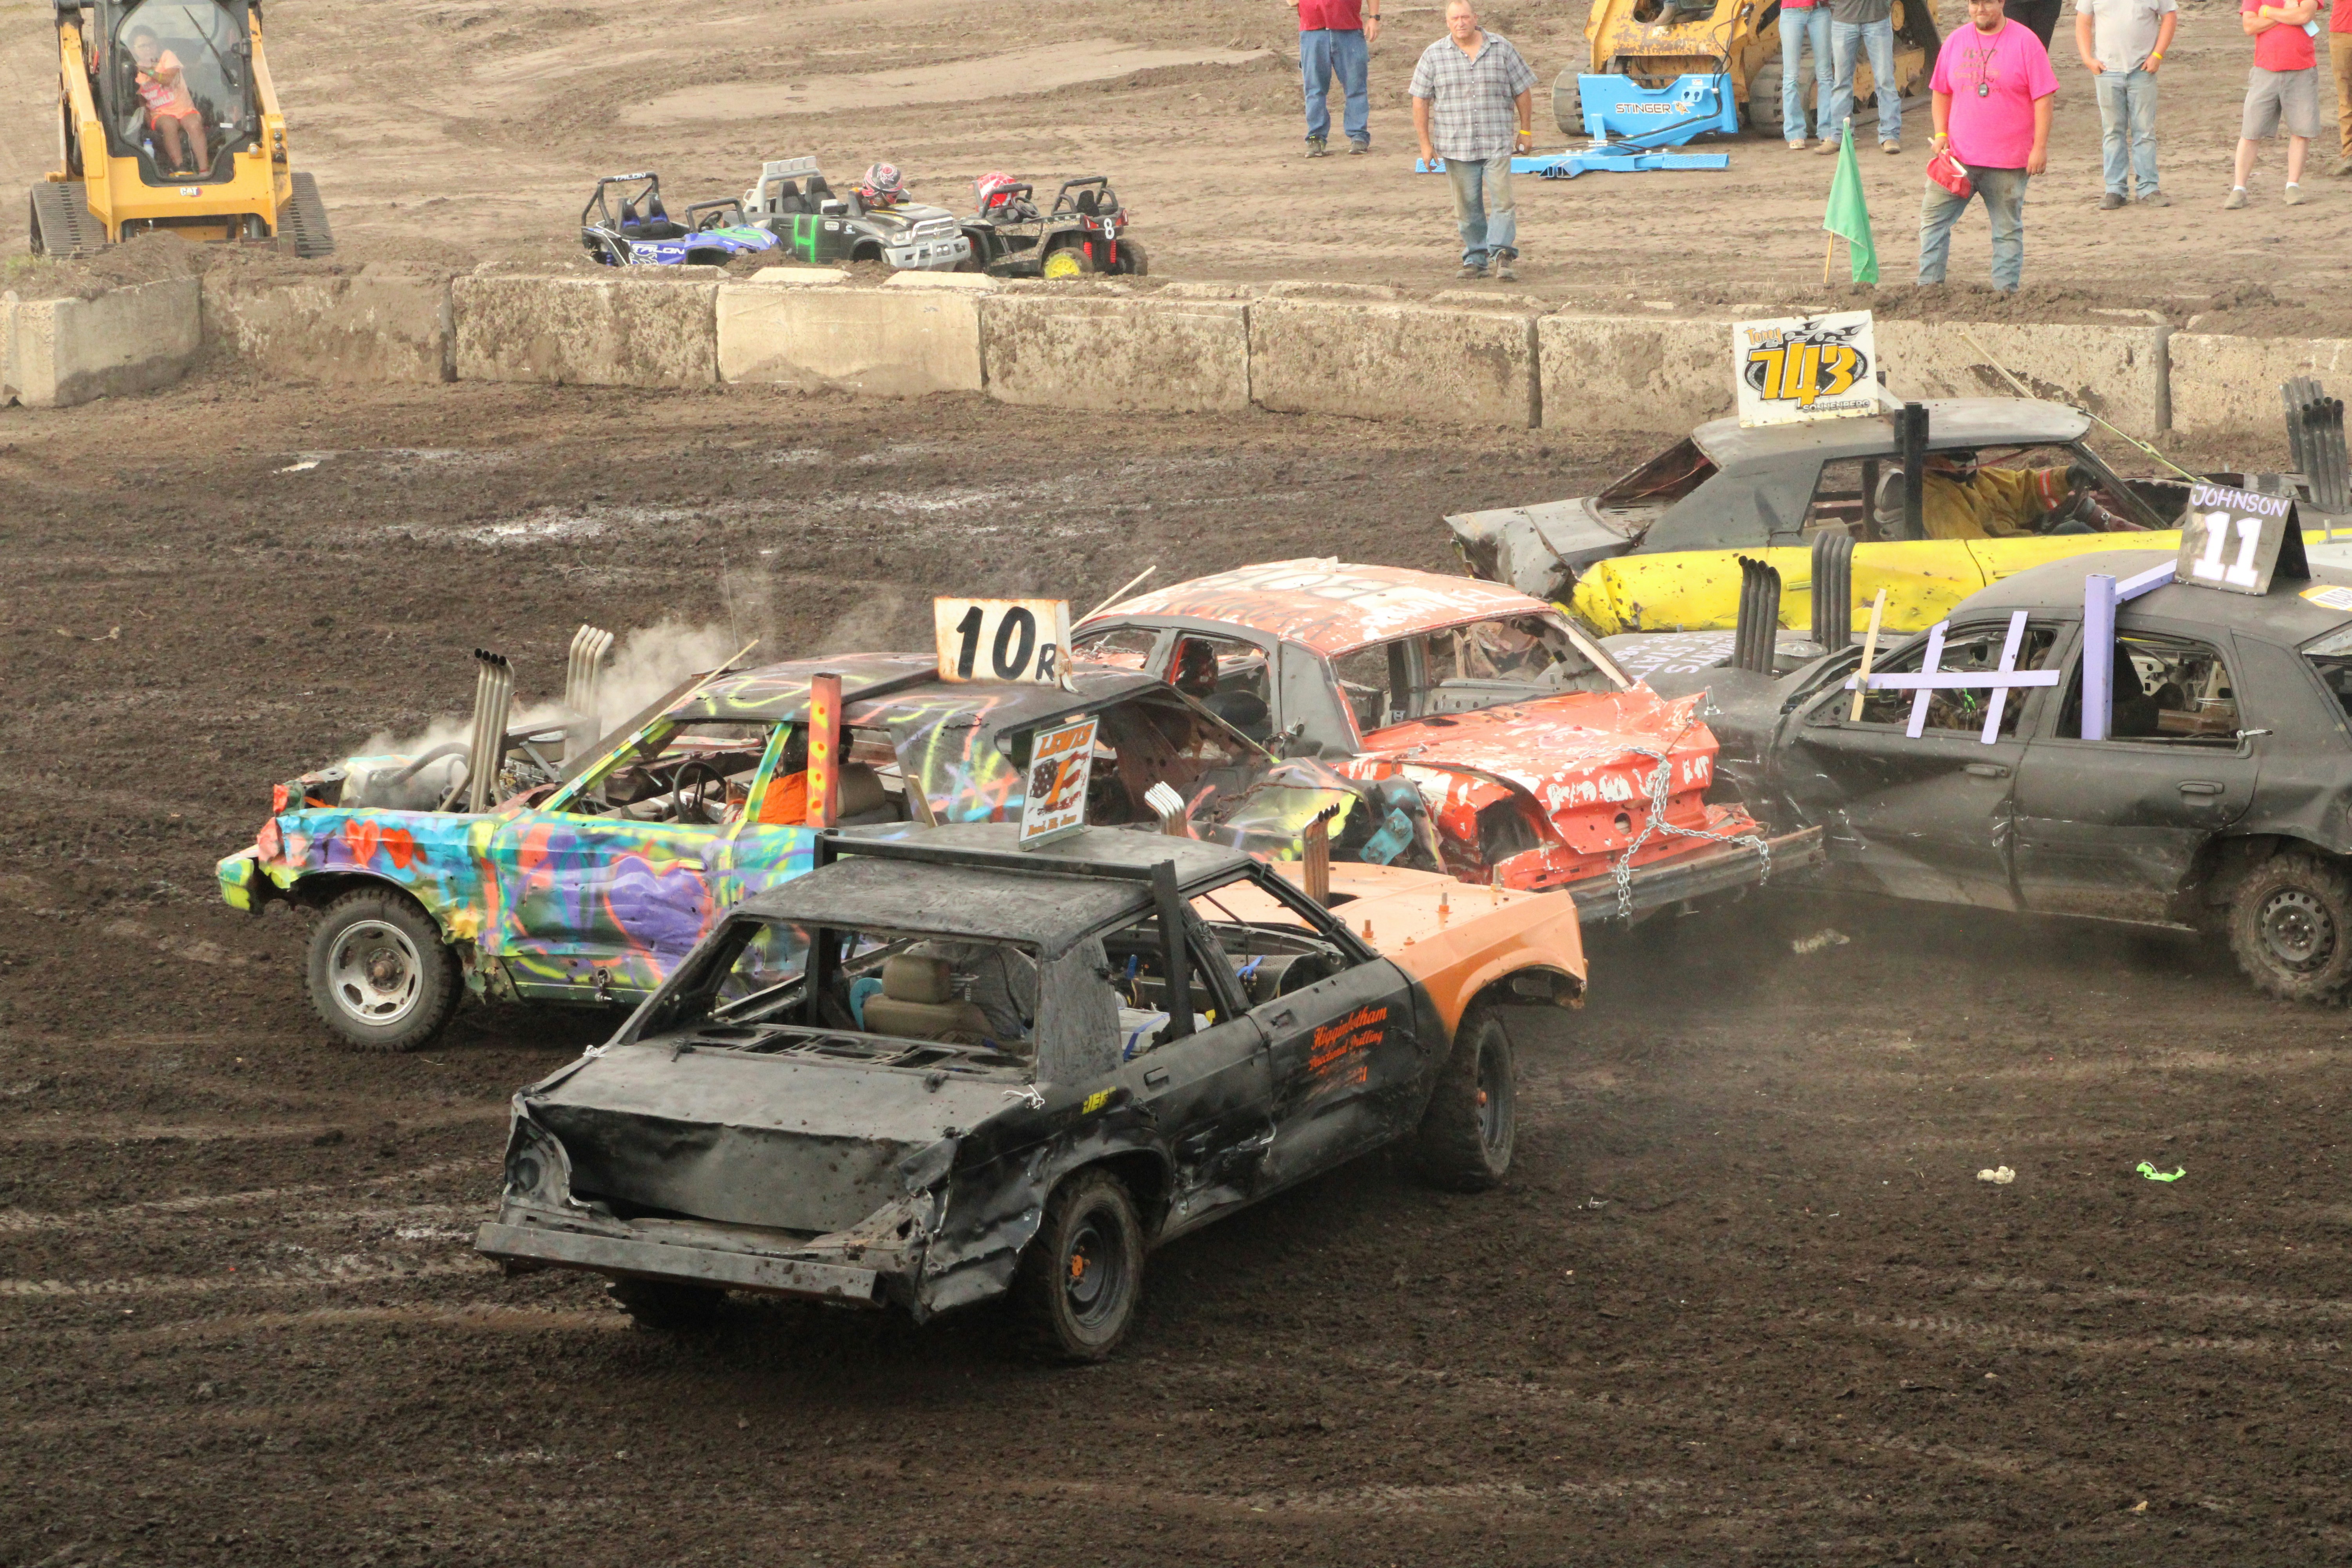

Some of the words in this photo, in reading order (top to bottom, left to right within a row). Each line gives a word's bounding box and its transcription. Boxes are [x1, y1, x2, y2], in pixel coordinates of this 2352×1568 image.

[1615, 103, 1671, 114] STINGER
[613, 172, 646, 181] TALON
[180, 187, 198, 196] CAT
[794, 214, 818, 263] 4
[1103, 218, 1115, 240] 8
[632, 244, 685, 255] TALON
[1744, 327, 1782, 345] Torey
[1746, 339, 1857, 410] 743
[1802, 399, 1871, 413] SONNENBERG
[2192, 484, 2288, 517] JOHNSON
[2192, 511, 2263, 588] 11
[1034, 722, 1095, 760] LEWIS
